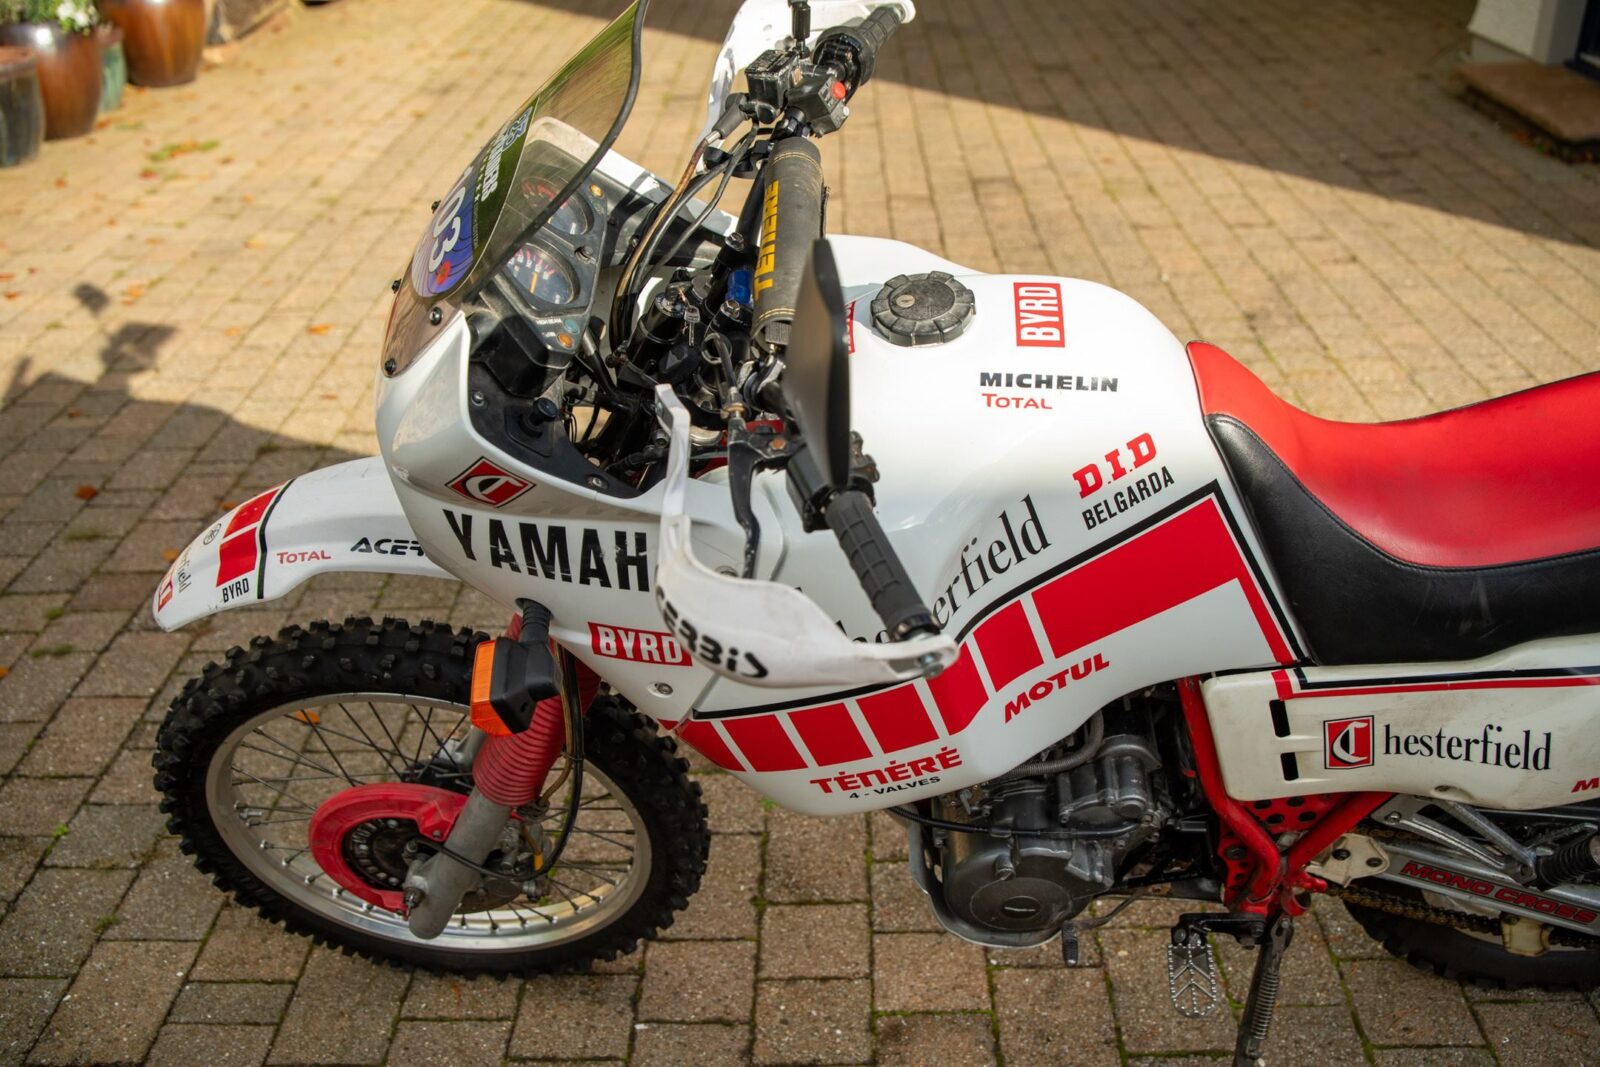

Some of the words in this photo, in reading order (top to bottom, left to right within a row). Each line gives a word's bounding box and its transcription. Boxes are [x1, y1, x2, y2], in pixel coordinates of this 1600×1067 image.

[1018, 283, 1061, 342] BYRD
[979, 371, 1119, 393] MICHELIN
[981, 393, 1053, 410] TOTAL
[1081, 465, 1175, 531] BELGARDA
[276, 550, 332, 564] TOTAL
[350, 537, 424, 556] ACER
[442, 508, 650, 592] YAMAH
[222, 578, 250, 603] BYRD
[600, 626, 684, 664] BYRD
[1004, 653, 1110, 723] MOTUL
[873, 776, 941, 795] VALVES
[1401, 861, 1495, 895] MONO
[1494, 887, 1598, 925] CROSS
